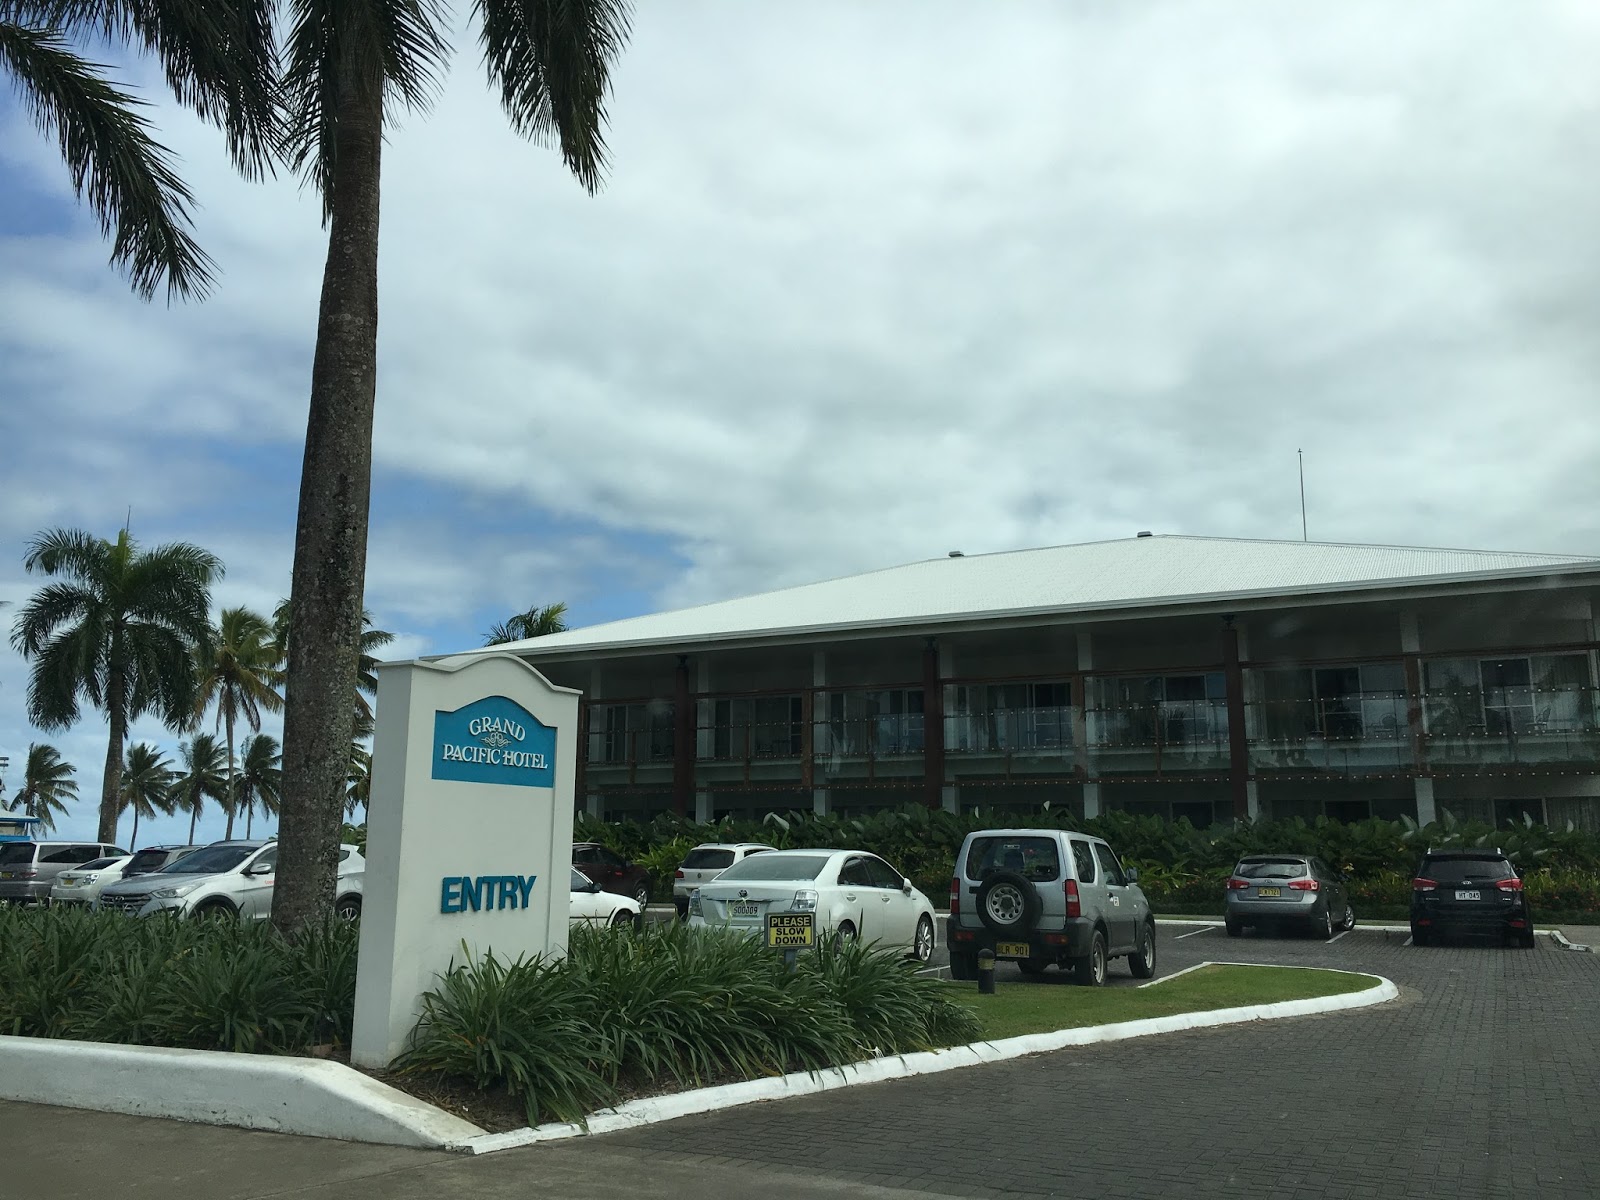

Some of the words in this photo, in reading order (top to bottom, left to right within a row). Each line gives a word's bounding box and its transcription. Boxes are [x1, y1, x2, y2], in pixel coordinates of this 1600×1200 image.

[469, 716, 526, 741] GRAND
[442, 743, 501, 765] PACIFIC
[502, 750, 548, 769] HOTEL
[441, 875, 537, 913] ENTRY
[771, 916, 810, 927] PLEASE
[775, 936, 806, 944] DOWN
[776, 927, 805, 936] SLOW
